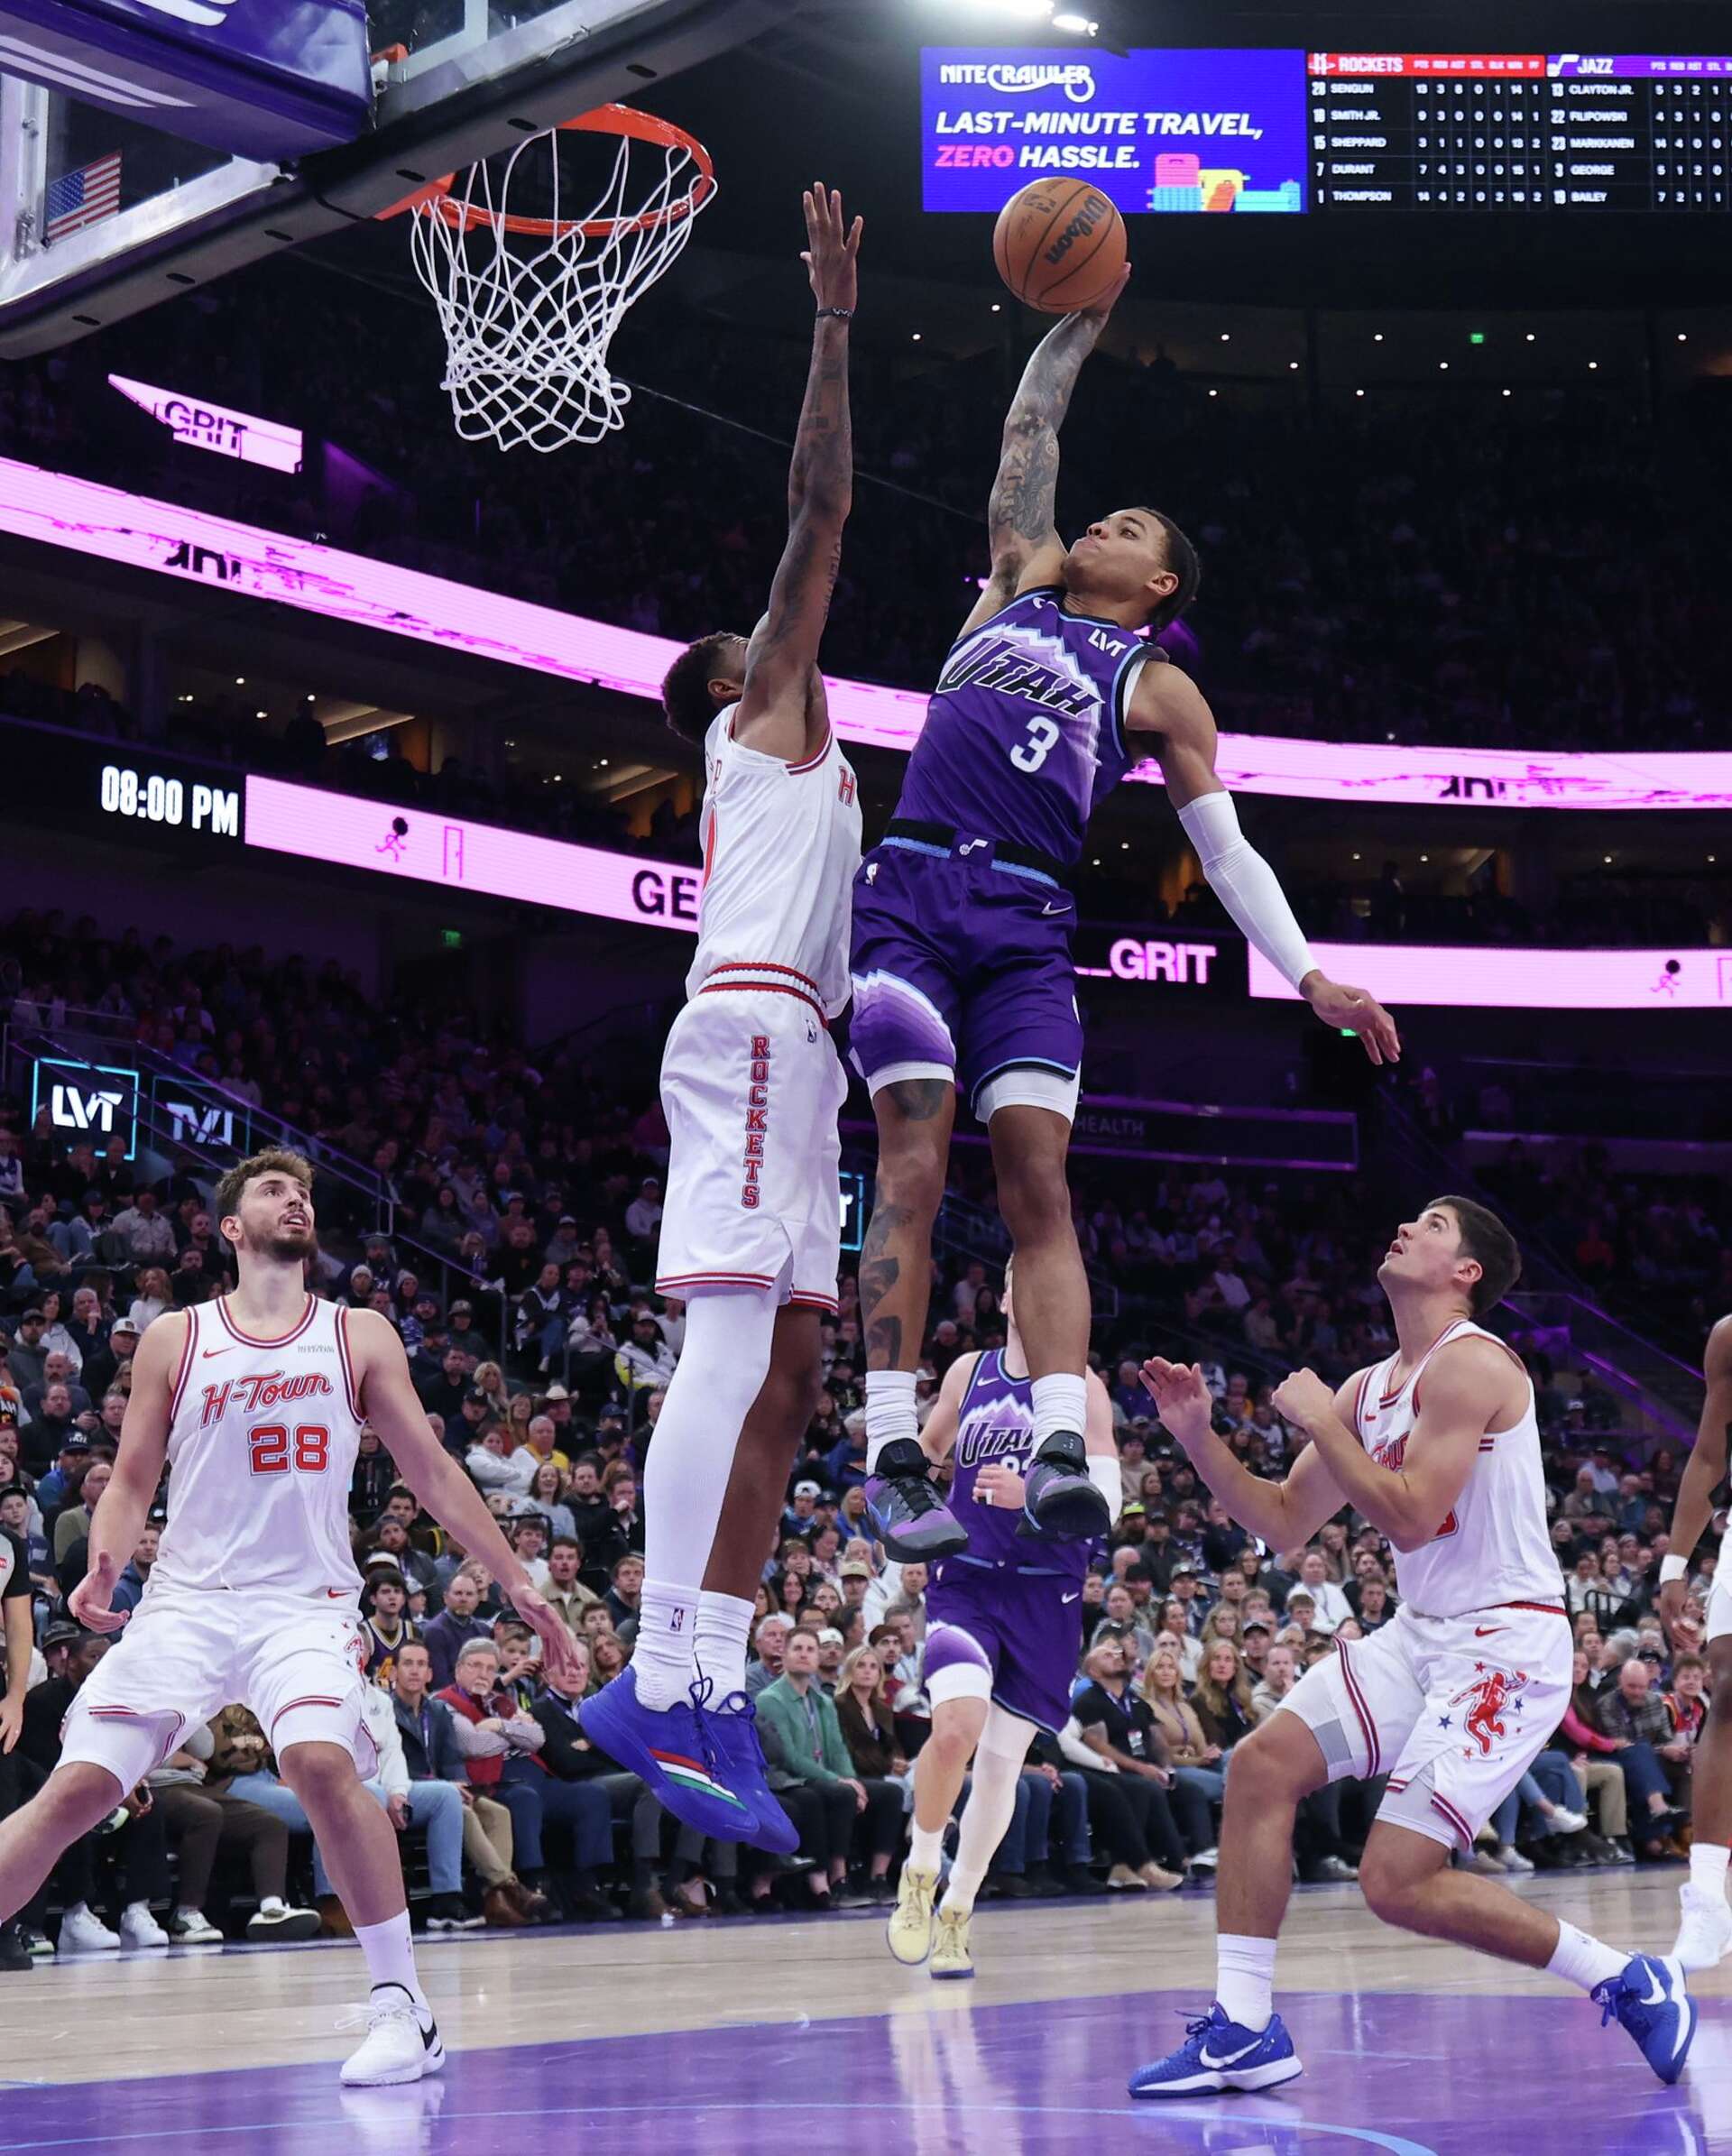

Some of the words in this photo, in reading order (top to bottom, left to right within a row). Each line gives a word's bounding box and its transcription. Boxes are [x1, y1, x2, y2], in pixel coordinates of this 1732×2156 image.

[1339, 57, 1403, 72] ROCKETS
[1578, 59, 1614, 74] JAZZ
[940, 64, 1095, 103] NITECRAWLER
[1331, 83, 1374, 93] SENGUN
[1569, 85, 1617, 95] CLAYTON
[1617, 85, 1634, 95] JR.
[1331, 110, 1363, 120] SMITH
[1364, 111, 1380, 120] JR.
[1551, 110, 1565, 124] 22
[1570, 111, 1627, 121] FILIPOWSKI
[935, 112, 1137, 134] LAST-MINUTE
[1144, 113, 1263, 140] TRAVEL,
[1313, 135, 1326, 150] 15
[1331, 137, 1387, 147] SHEPPARD
[1571, 138, 1634, 148] MARKKANEN
[935, 145, 1015, 168] ZERO
[1018, 145, 1140, 168] HASSLE.
[1317, 162, 1324, 176] 7
[1332, 164, 1375, 174] DURANT
[1555, 163, 1563, 177] 3
[1571, 165, 1614, 175] GEORGE
[1318, 189, 1323, 203] 1
[1332, 191, 1391, 201] THOMPSON
[1571, 192, 1607, 201] BAILEY
[1088, 629, 1127, 657] LVT
[936, 637, 1105, 717] UTAH
[1009, 715, 1059, 773] 3
[101, 765, 182, 825] 08:00
[191, 785, 238, 836] PM
[51, 1084, 124, 1132] LVT
[742, 1035, 769, 1210] ROCKETS
[200, 1369, 334, 1430] H-Town
[247, 1423, 331, 1477] 28
